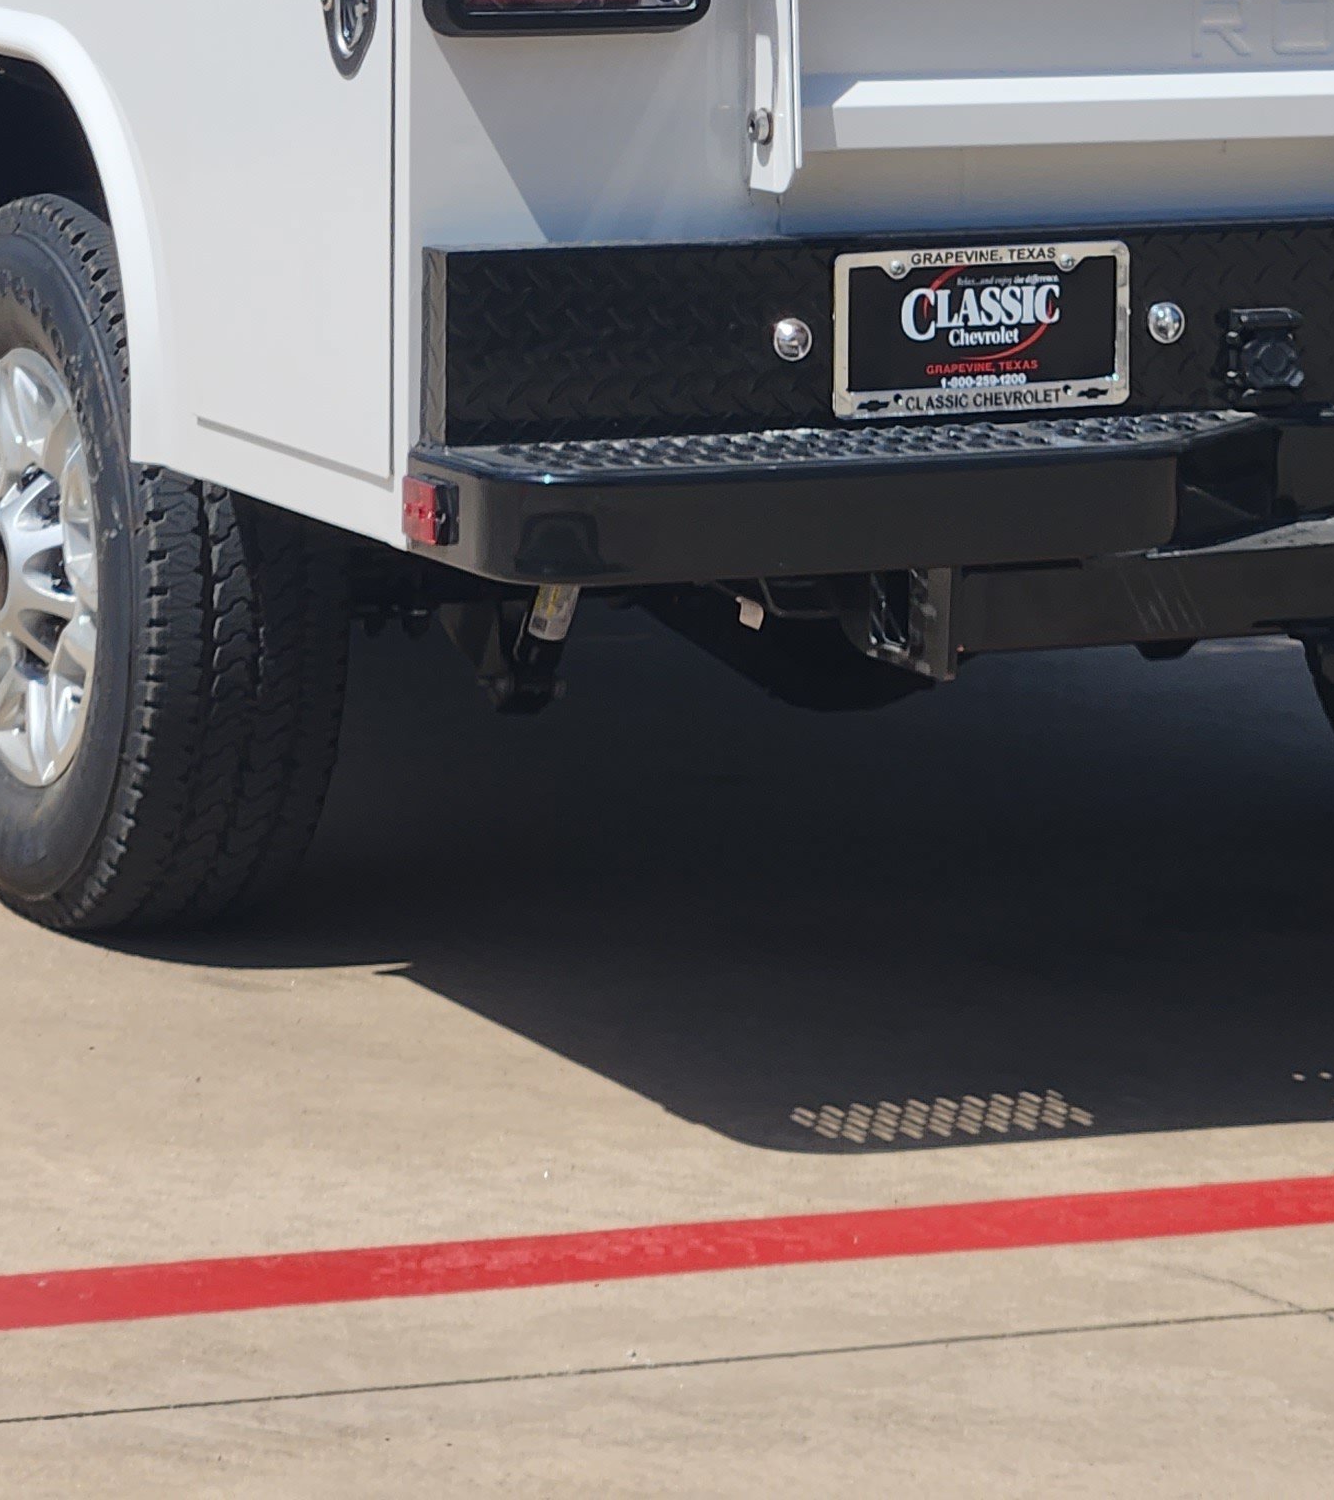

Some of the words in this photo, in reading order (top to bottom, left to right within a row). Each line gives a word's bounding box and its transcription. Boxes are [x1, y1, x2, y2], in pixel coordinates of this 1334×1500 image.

[911, 249, 1003, 266] GRAPEVINE,
[1008, 247, 1056, 261] TEXAS
[901, 284, 1061, 342] CLASSIC
[948, 326, 1020, 348] Chevrolet
[925, 362, 995, 376] GRAPEVINE,
[998, 360, 1039, 371] TEXAS
[905, 393, 968, 412] CLASSIC
[973, 389, 1061, 408] CHEVROLET
